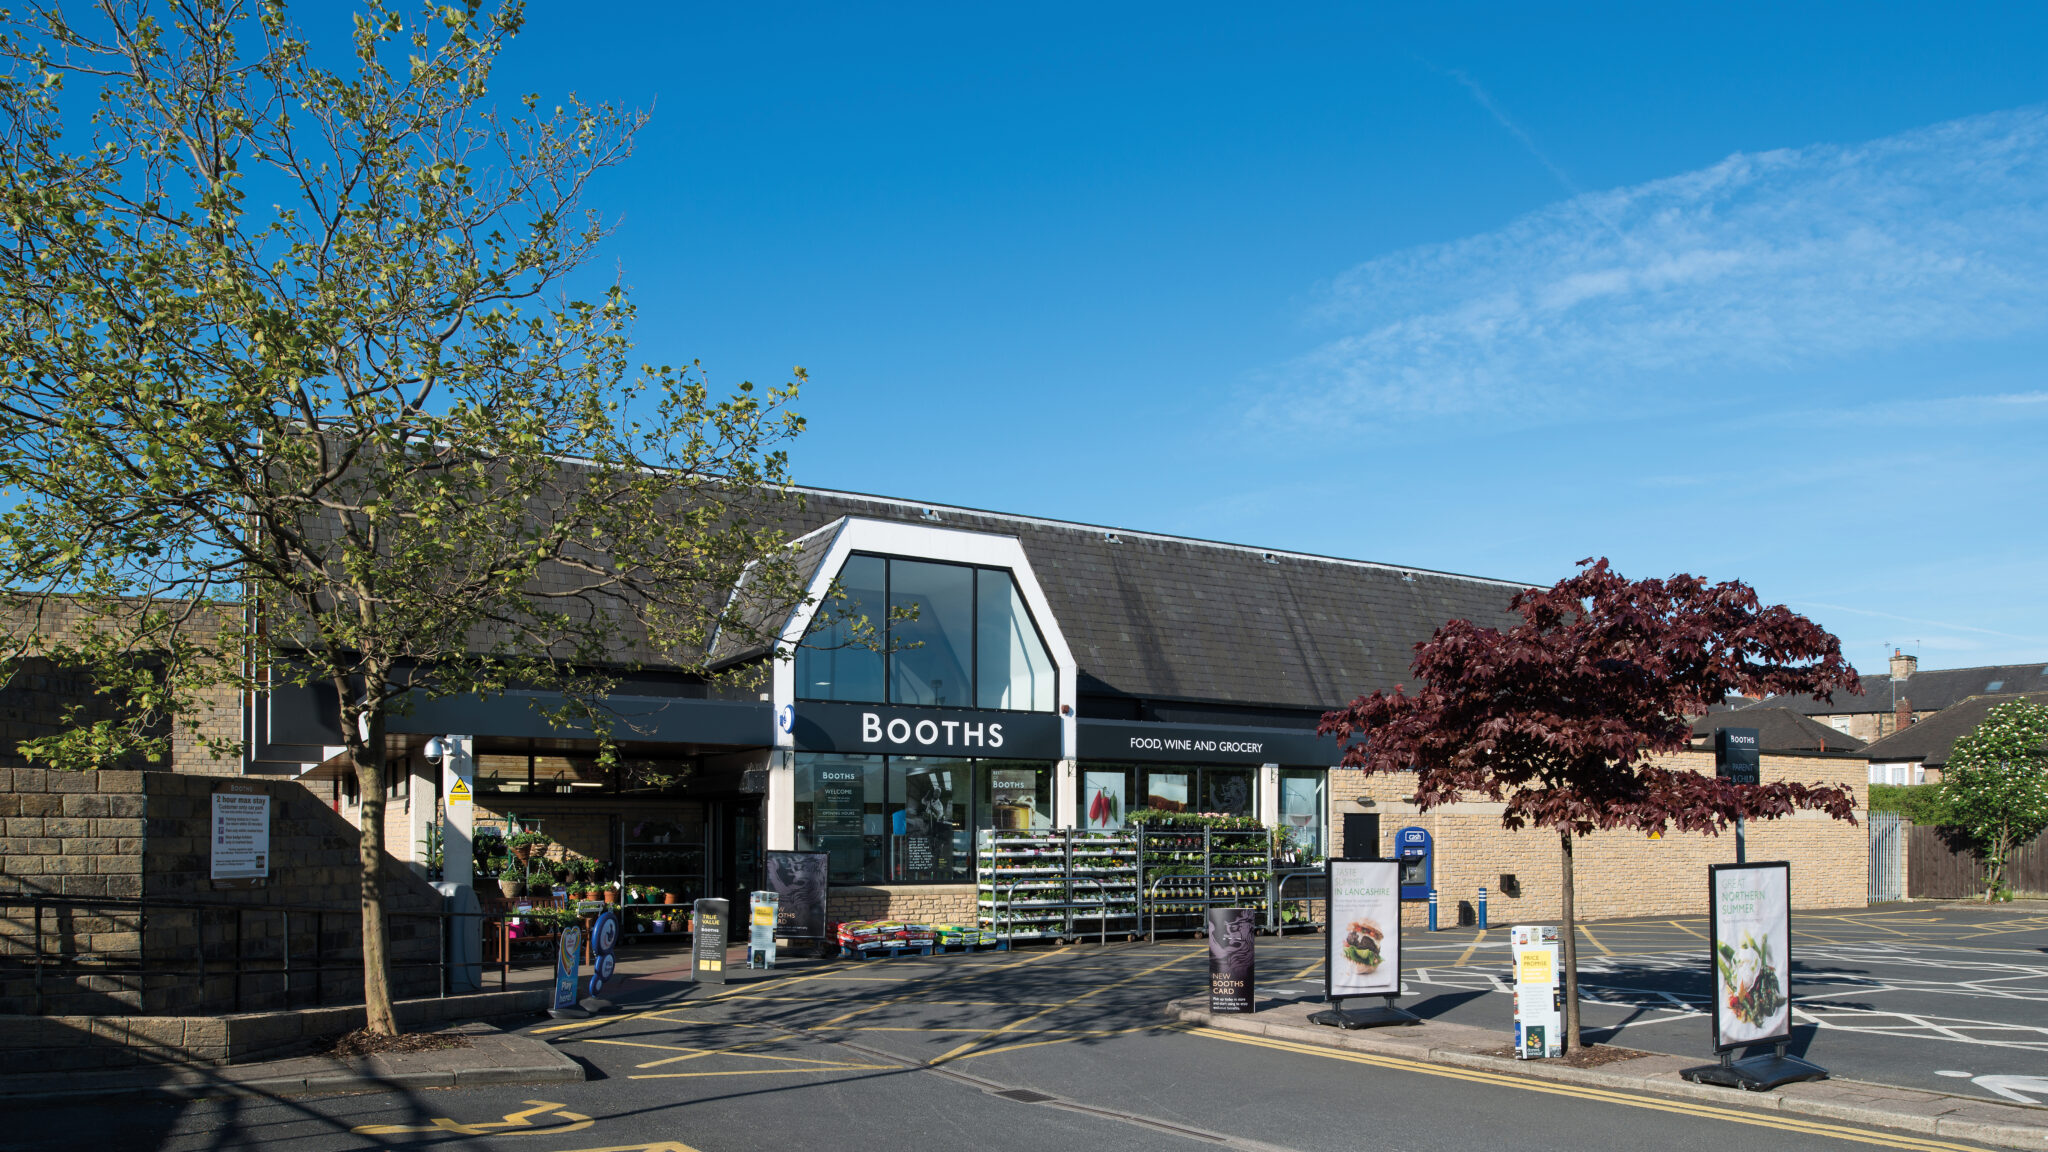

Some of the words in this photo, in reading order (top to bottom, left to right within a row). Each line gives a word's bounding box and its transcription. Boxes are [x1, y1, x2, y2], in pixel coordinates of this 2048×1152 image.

[863, 713, 1003, 748] BOOTHS
[1730, 735, 1754, 744] BOOTHS
[1130, 738, 1162, 751] FOOD,
[1164, 739, 1191, 750] WINE
[1193, 741, 1216, 751] AND
[1219, 742, 1262, 753] GROCERY
[823, 771, 855, 780] BOOTHS
[1737, 775, 1754, 783] CHILD
[993, 780, 1025, 789] BOOTHS
[216, 795, 221, 803] 2
[253, 797, 266, 806] stay
[1408, 833, 1421, 841] cash
[1336, 868, 1357, 877] TASTE
[1335, 878, 1364, 887] SUMMER
[1721, 879, 1746, 889] GREAT
[1335, 888, 1342, 896] IN
[1345, 888, 1390, 896] LANCASHIRE
[1721, 890, 1765, 902] NORTHERN
[1722, 904, 1754, 915] SUMMER
[561, 981, 573, 992] Play
[1213, 980, 1244, 988] BOOTHS
